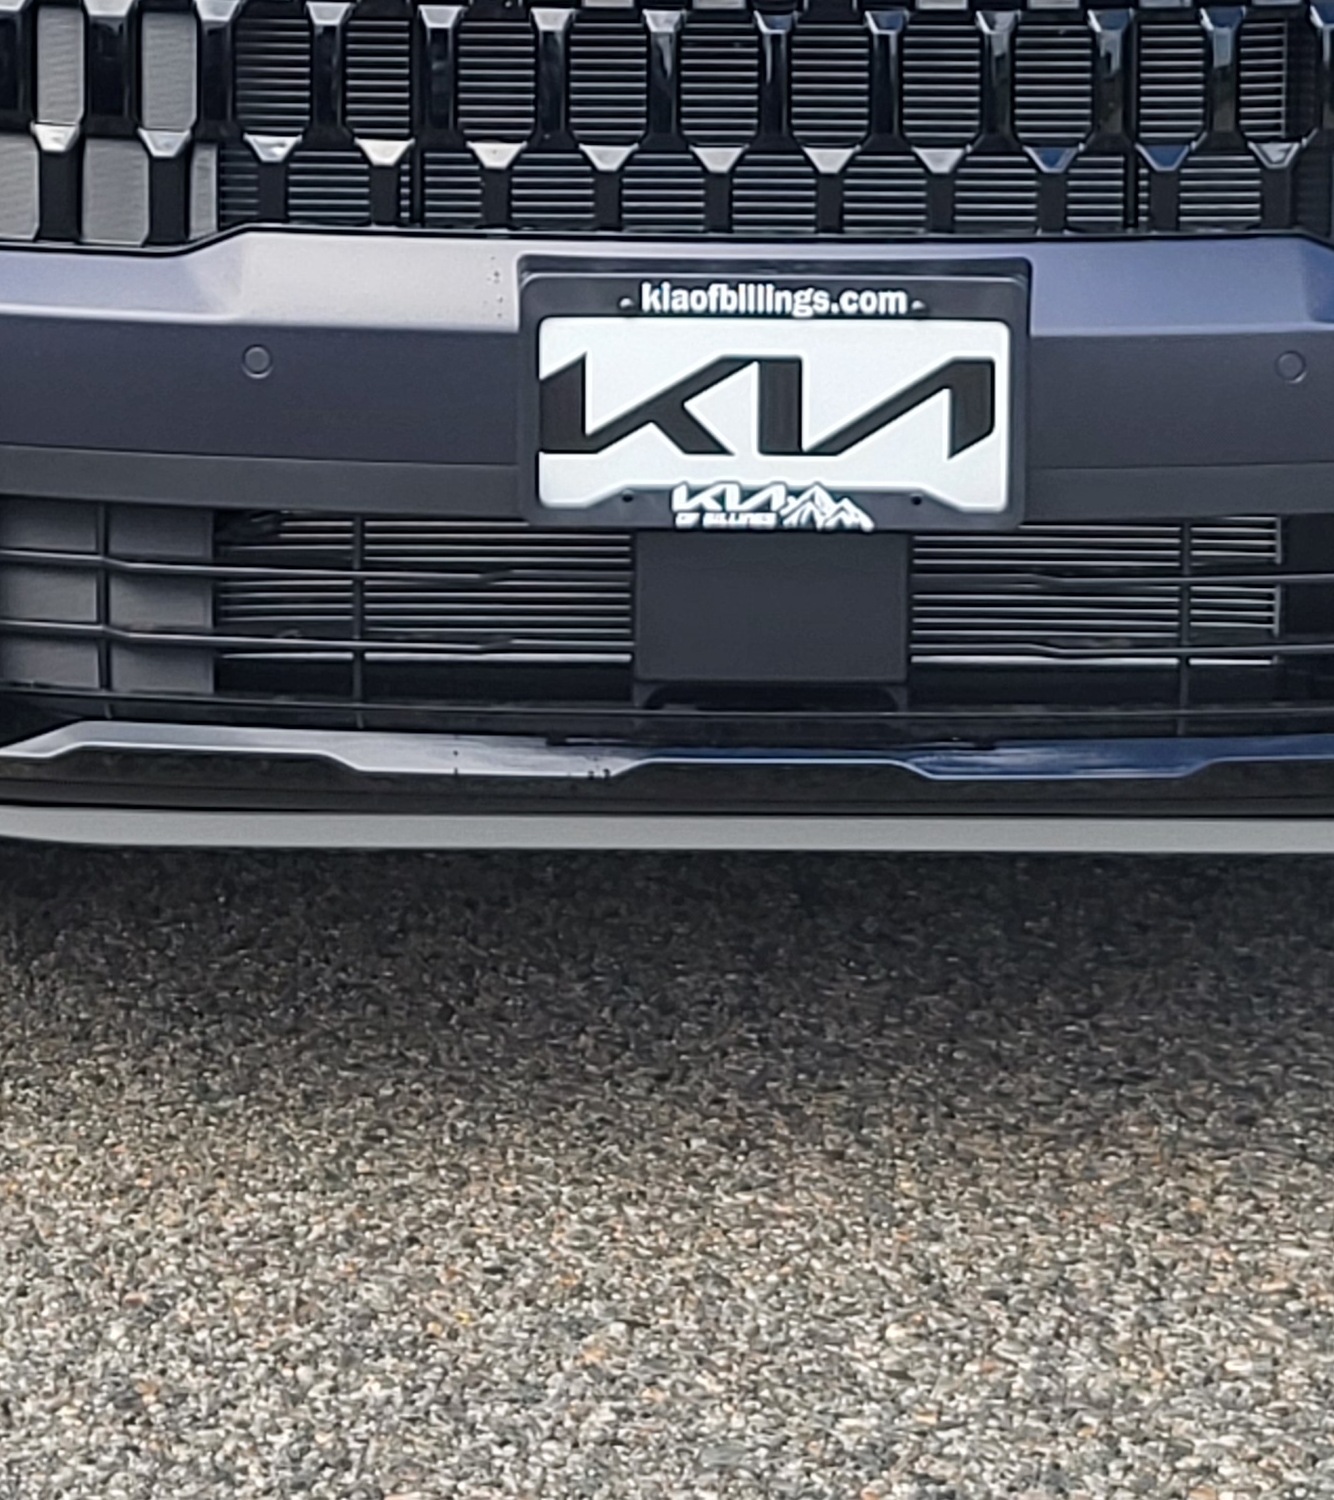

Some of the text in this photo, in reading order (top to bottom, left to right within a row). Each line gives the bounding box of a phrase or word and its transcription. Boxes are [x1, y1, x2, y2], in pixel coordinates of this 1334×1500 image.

[640, 281, 908, 318] kiaofbillings.com
[539, 352, 997, 460] KIA
[672, 482, 787, 511] KIA
